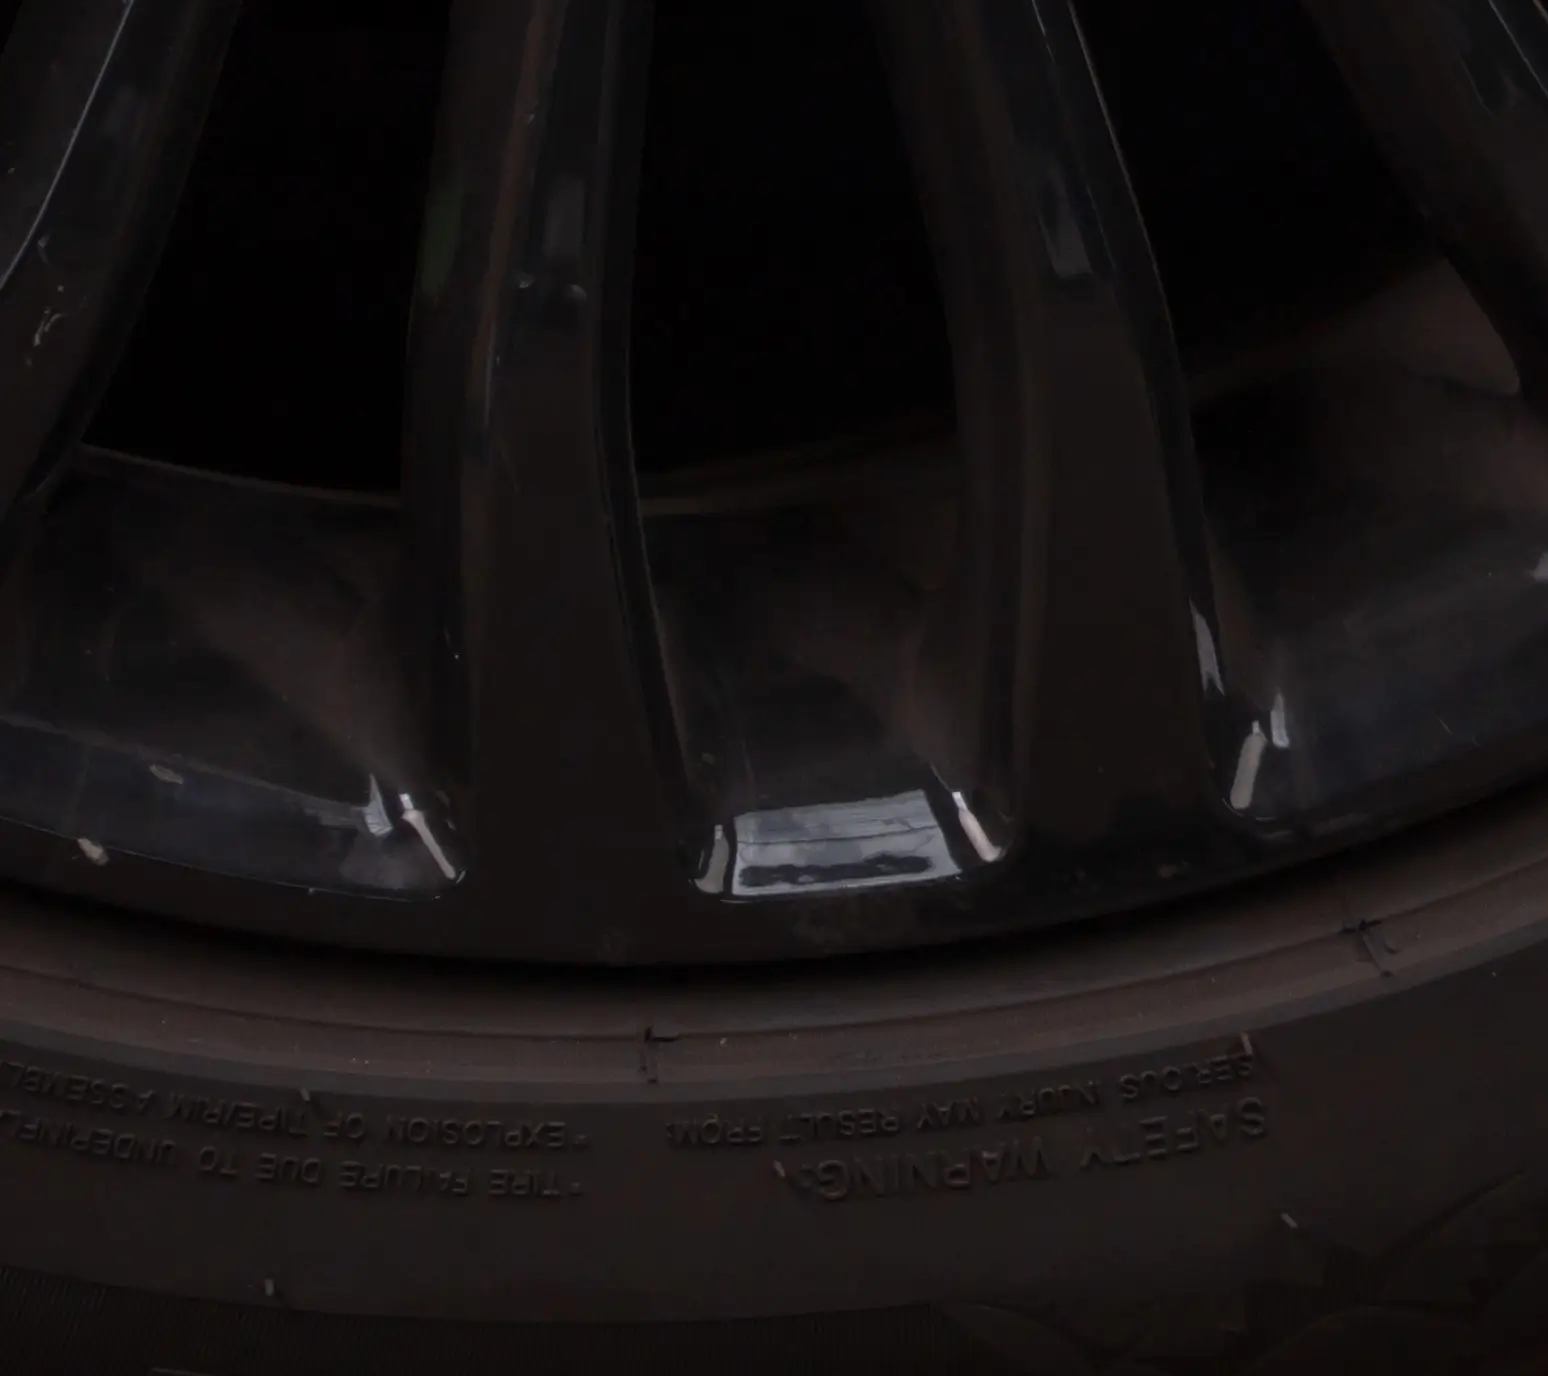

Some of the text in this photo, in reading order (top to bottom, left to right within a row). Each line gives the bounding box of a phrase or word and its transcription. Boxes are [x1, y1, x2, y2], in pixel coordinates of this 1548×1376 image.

[322, 1110, 365, 1140] OF
[778, 1107, 900, 1142] RESULT
[914, 1094, 981, 1131] MAY
[386, 1115, 567, 1149] EXPLOSION
[1079, 1096, 1266, 1169] SAFETY
[199, 1145, 238, 1175] TO
[256, 1151, 322, 1185] DUE
